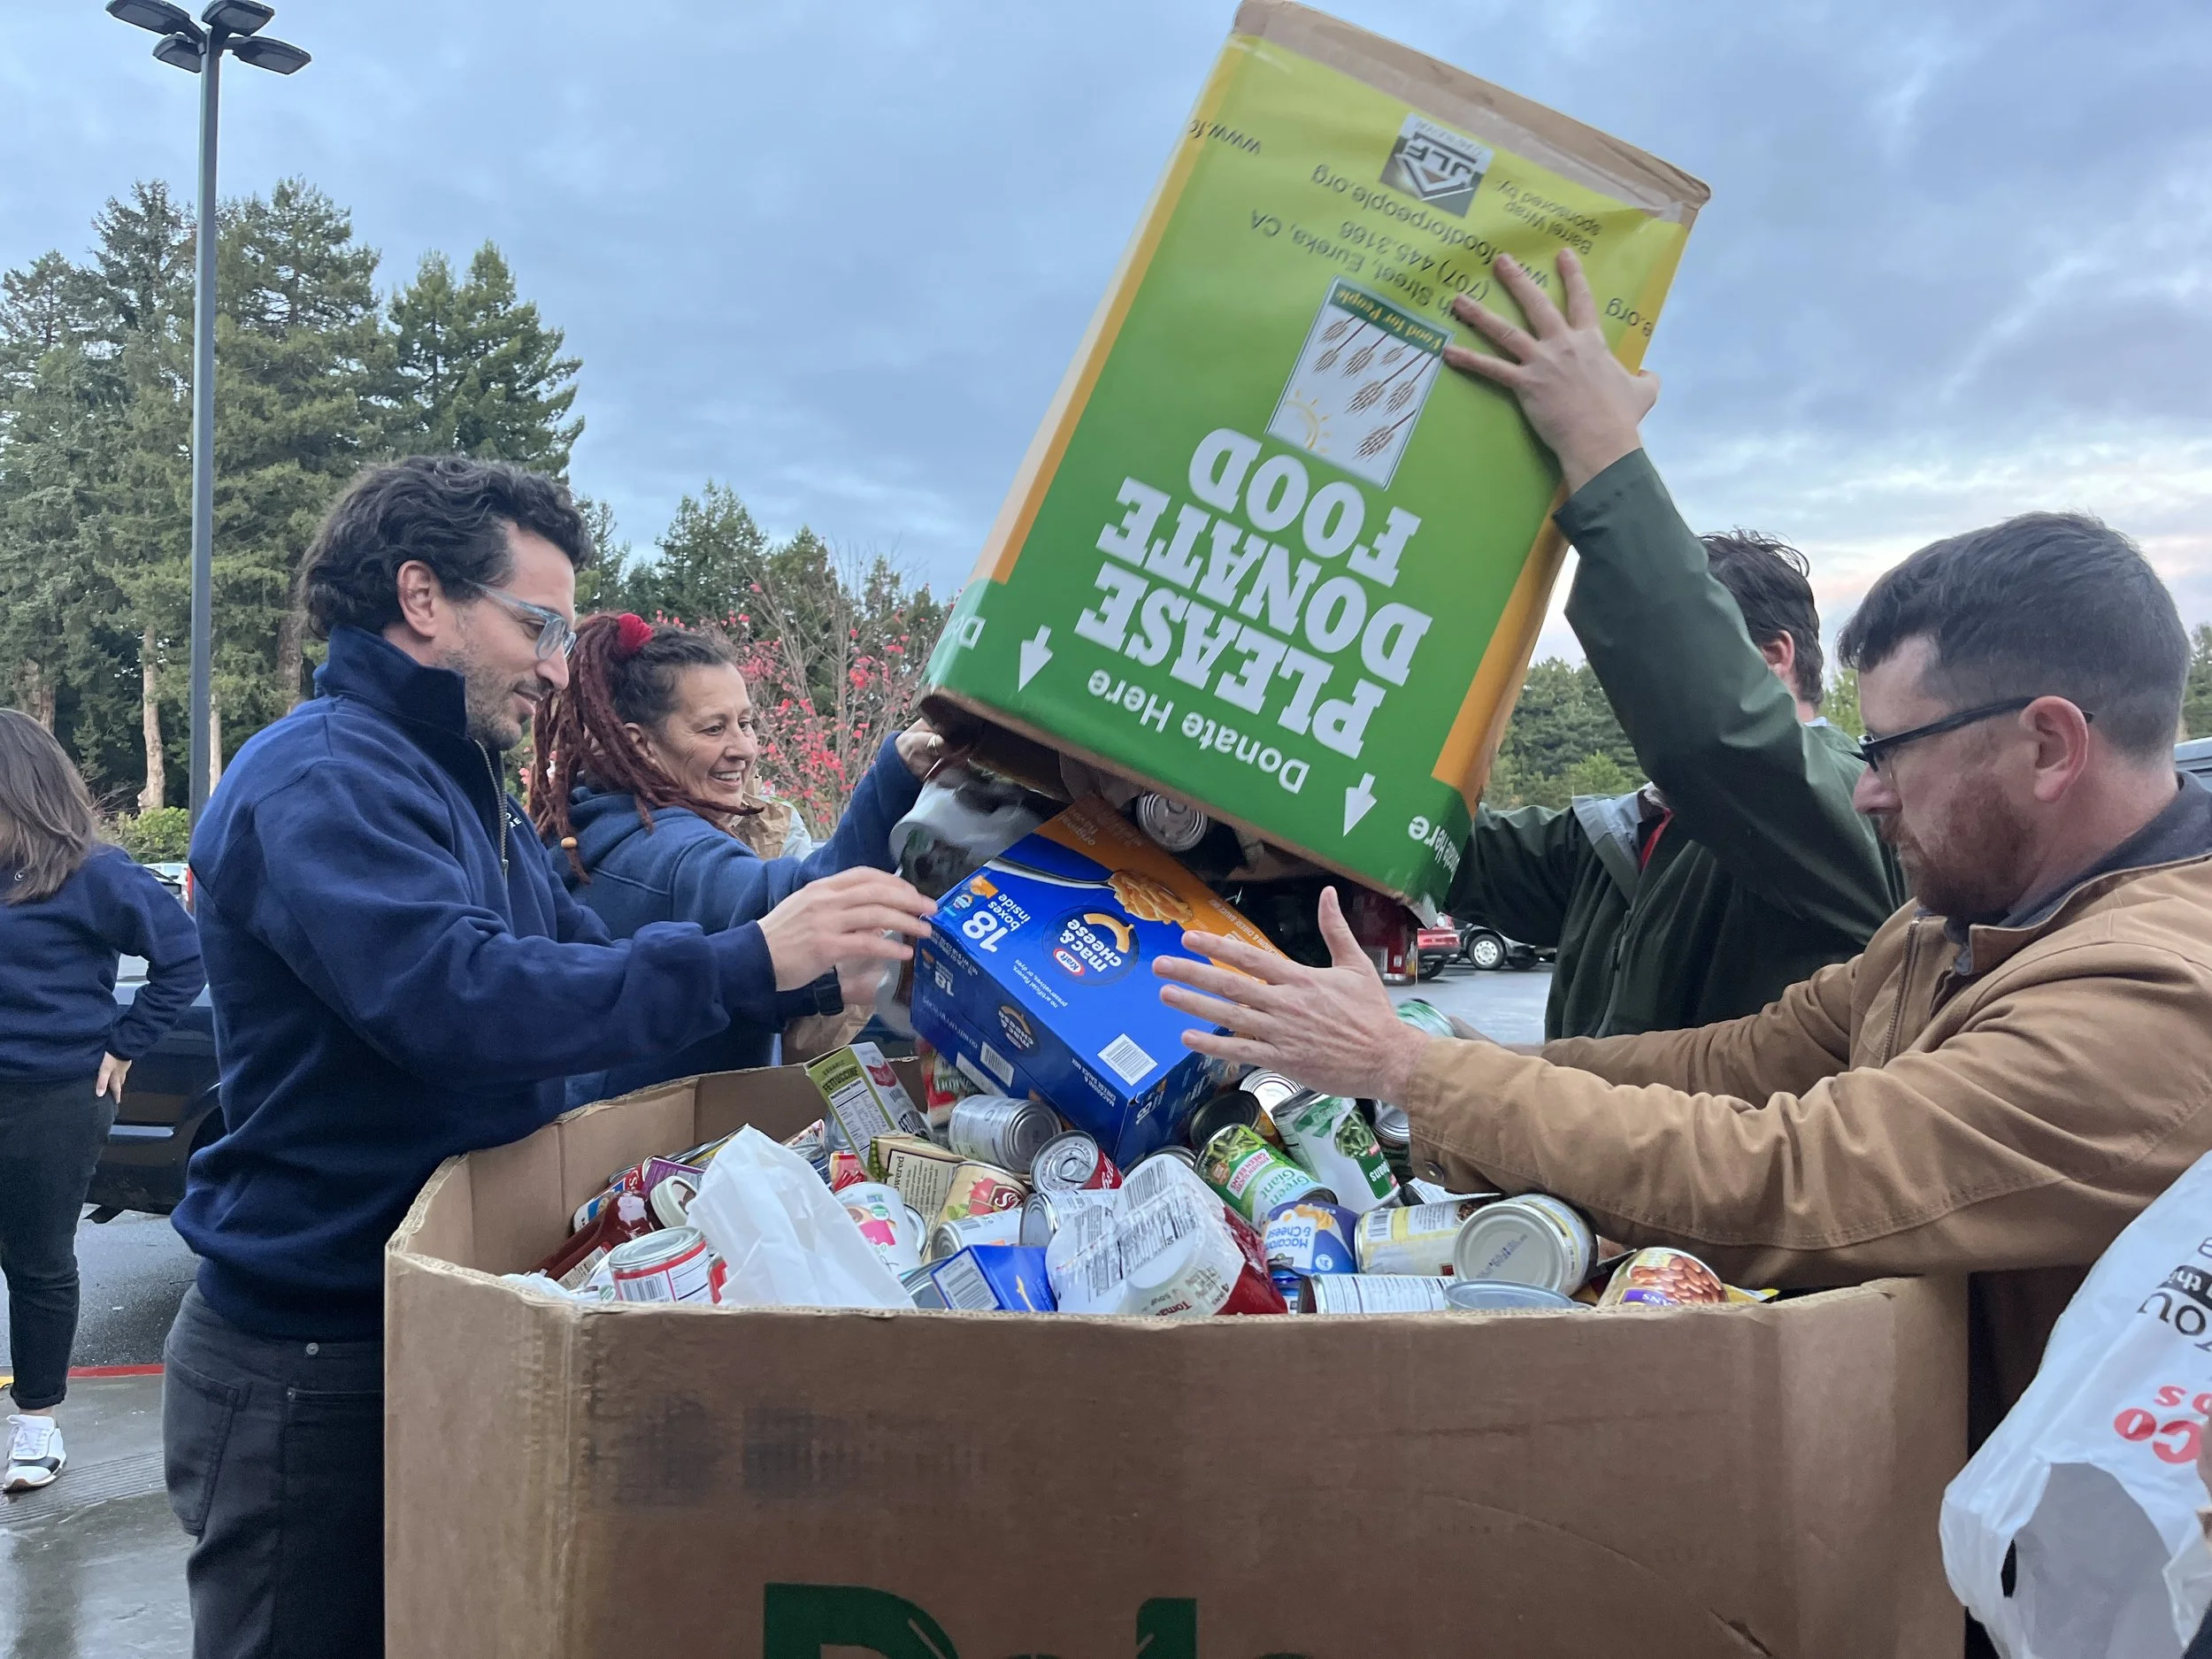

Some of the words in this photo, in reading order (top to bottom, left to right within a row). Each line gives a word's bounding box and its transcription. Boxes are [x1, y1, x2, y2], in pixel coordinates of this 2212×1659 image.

[1403, 140, 1473, 183] JLF
[1248, 209, 1281, 238] CA
[1502, 201, 1547, 232] Wrap
[1288, 223, 1366, 273] Eureka,
[1544, 219, 1594, 257] Barrel
[1365, 257, 1435, 308] Street,
[1437, 257, 1490, 302] (707)
[1333, 287, 1383, 320] People
[1606, 297, 1654, 337] e.org
[1380, 312, 1405, 334] for
[1403, 322, 1443, 352] Food
[1187, 427, 1422, 588] FOOD
[1094, 476, 1432, 687] DONATE
[1072, 561, 1386, 760] PLEASE
[1086, 668, 1174, 733] Here
[1180, 710, 1310, 795] Donate
[1407, 815, 1449, 864] Here
[987, 901, 1019, 933] boxes
[997, 893, 1032, 924] inside
[961, 909, 999, 953] 18
[1057, 927, 1076, 948] &
[1014, 958, 1028, 972] dyes
[1058, 952, 1079, 972] Kraft
[1069, 937, 1109, 974] mac
[933, 970, 953, 996] 18
[1010, 964, 1031, 985] flavors,
[1025, 969, 1033, 978] or
[1028, 980, 1052, 1002] artificial
[1032, 973, 1068, 1007] preservatives,
[1049, 1000, 1058, 1009] no
[893, 1155, 904, 1191] owered
[1243, 1151, 1266, 1170] GREEN
[1246, 1155, 1270, 1175] KITCHEN
[1229, 1166, 1248, 1190] BEANS
[1233, 1172, 1250, 1192] SLICED
[1257, 1168, 1293, 1199] Giant
[1268, 1175, 1309, 1207] Green
[1302, 1225, 1311, 1236] &
